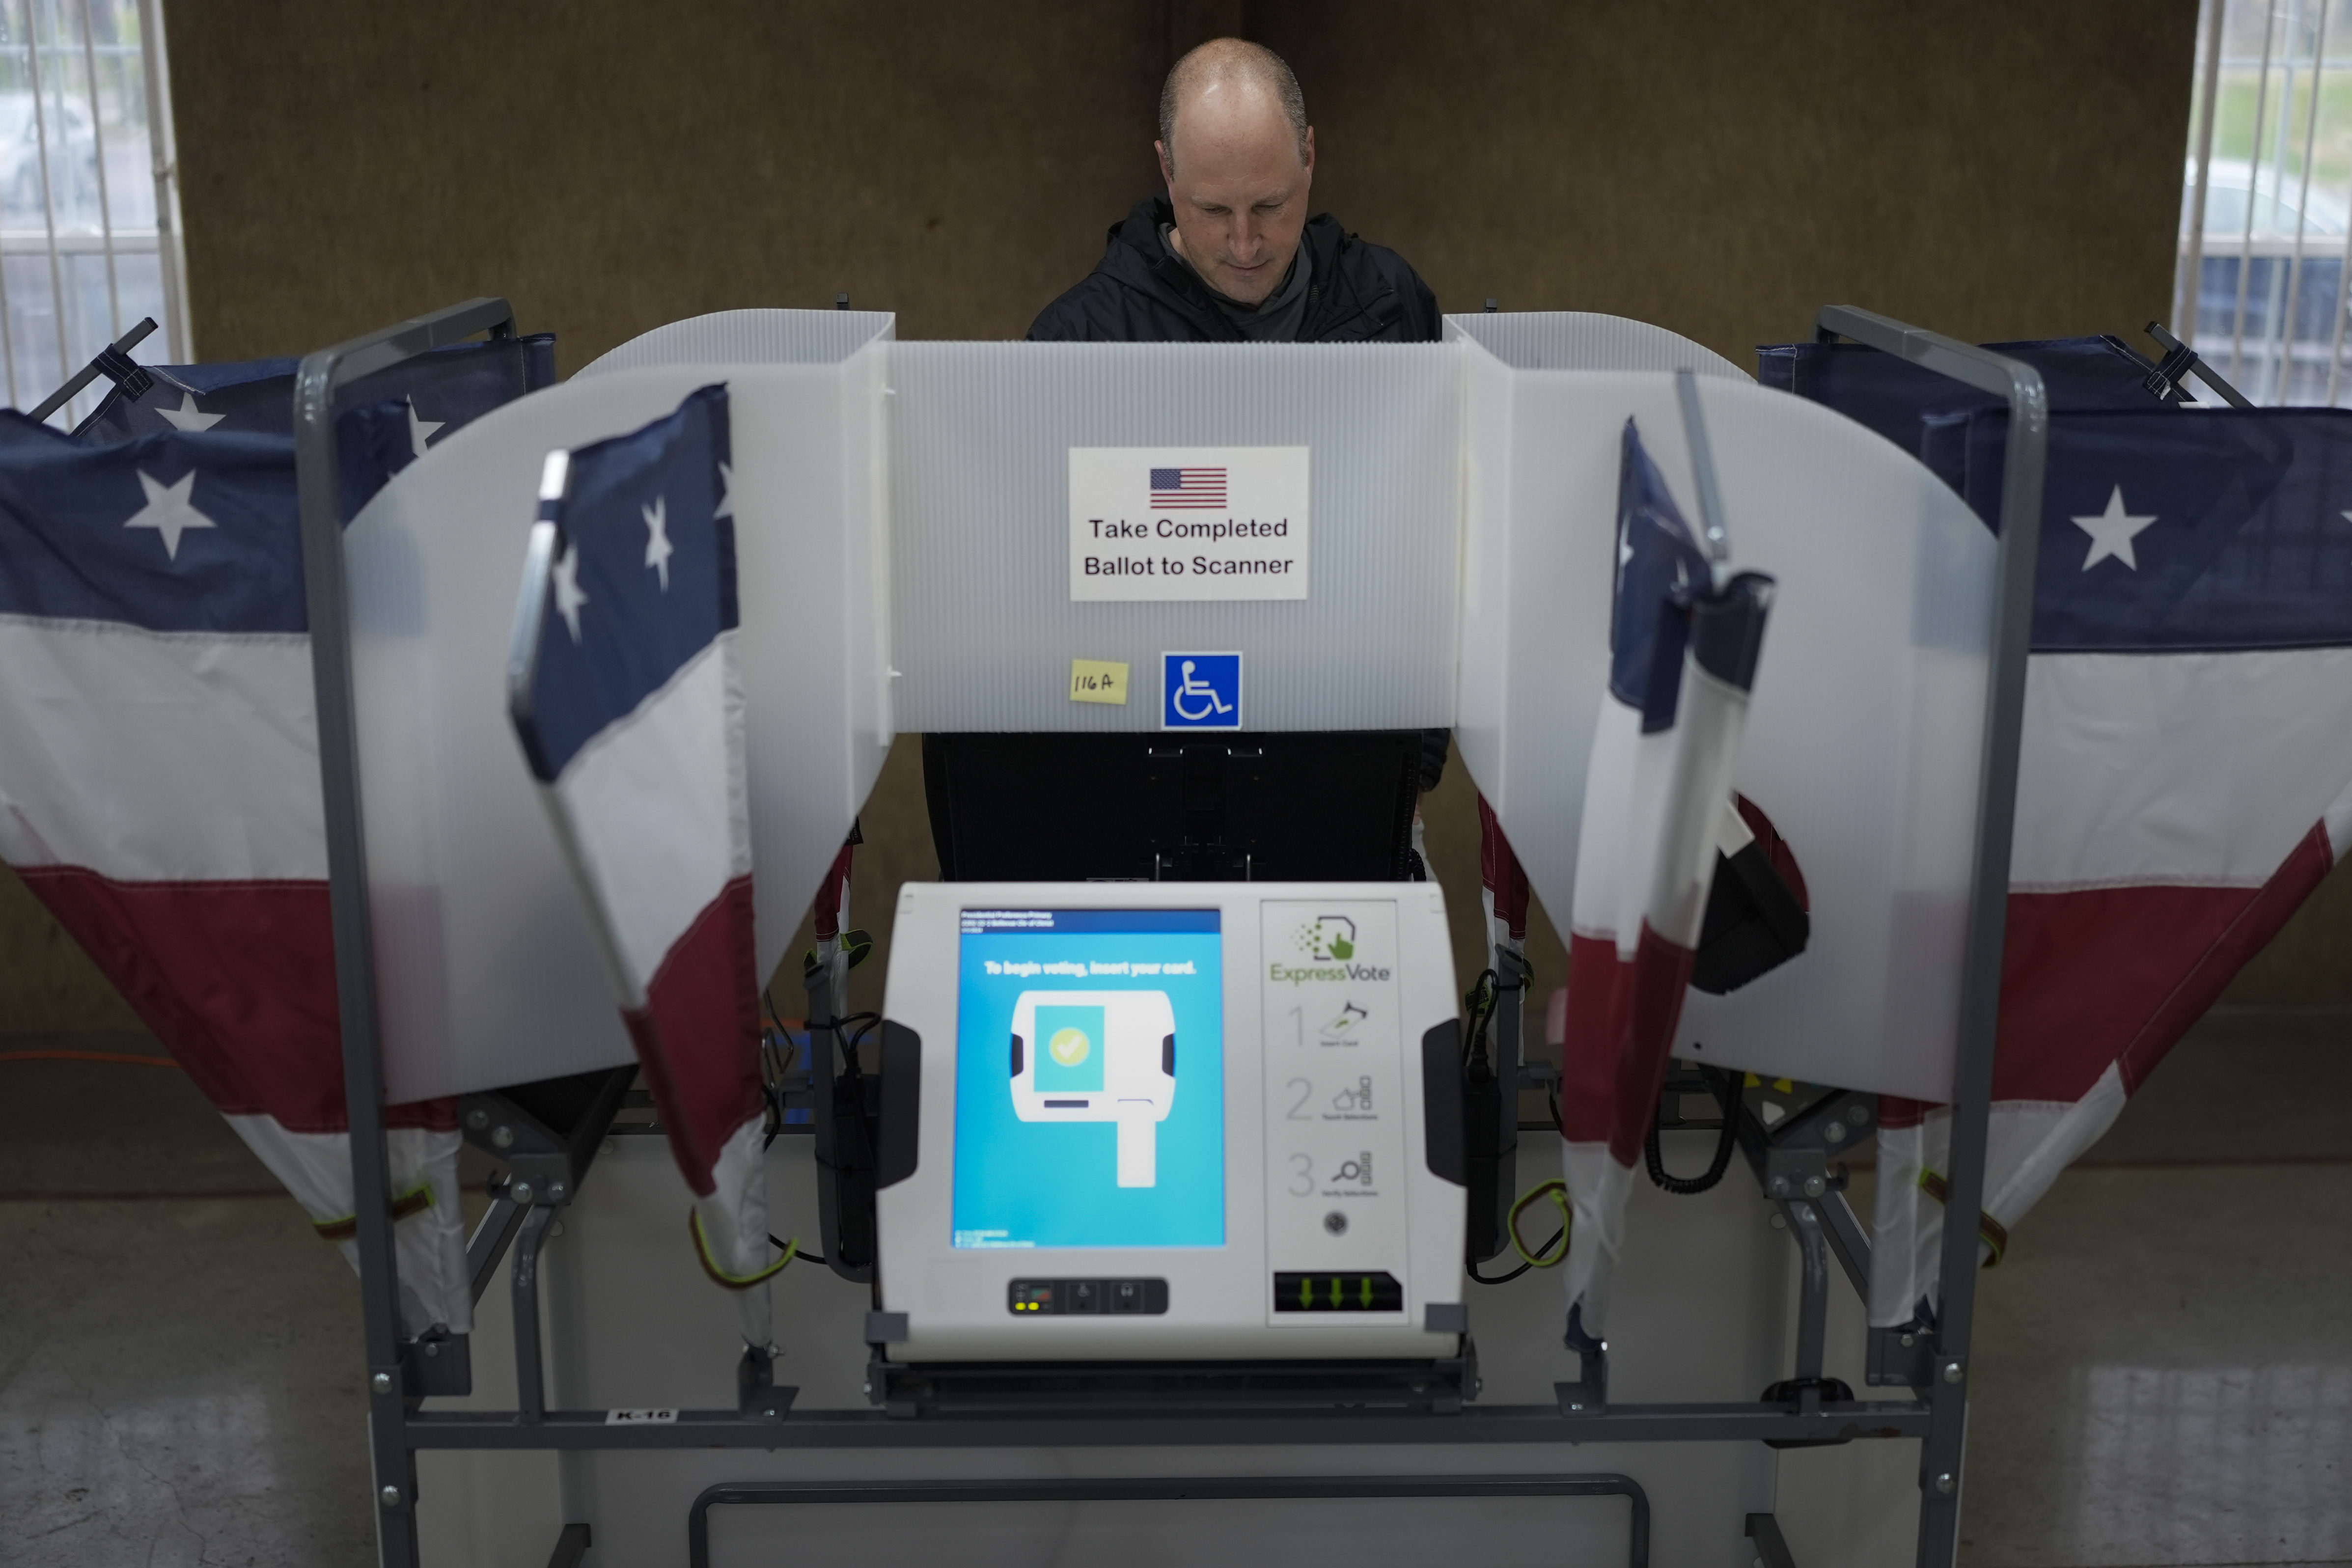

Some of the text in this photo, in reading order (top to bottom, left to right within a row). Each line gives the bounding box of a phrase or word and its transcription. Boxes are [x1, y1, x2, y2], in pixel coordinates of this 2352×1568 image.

[1089, 518, 1288, 542] Take Completed
[1084, 556, 1294, 576] Ballot to Scanner
[1075, 674, 1114, 691] 116A
[984, 960, 1002, 975] To
[1003, 960, 1042, 978] begin
[1089, 960, 1129, 975] insert
[1130, 963, 1161, 977] your
[1270, 963, 1390, 987] ExpressVote
[1289, 1005, 1303, 1046] 1
[1286, 1077, 1313, 1120] 2
[1288, 1153, 1315, 1198] 3
[617, 1410, 671, 1420] K-16
